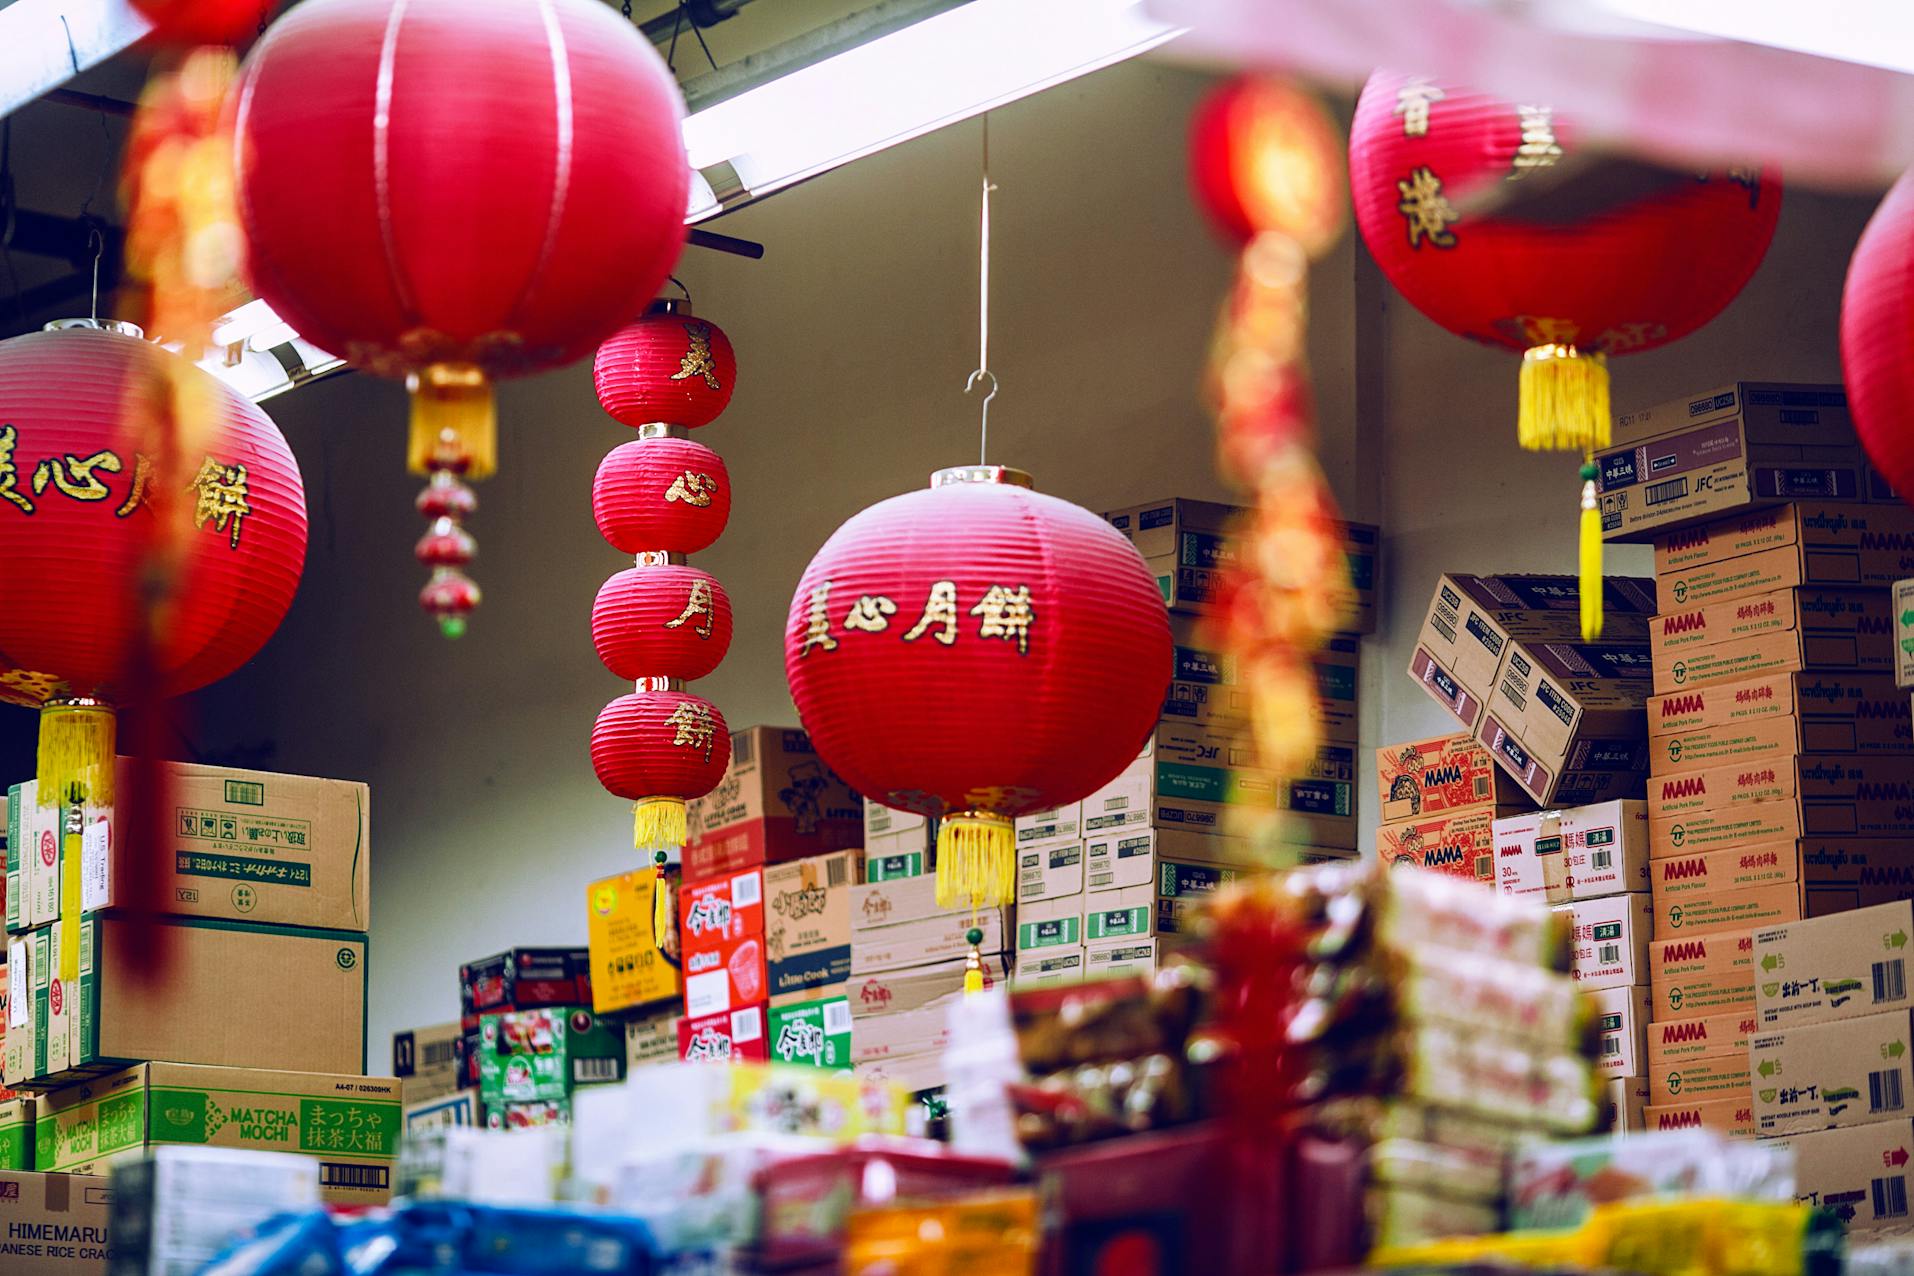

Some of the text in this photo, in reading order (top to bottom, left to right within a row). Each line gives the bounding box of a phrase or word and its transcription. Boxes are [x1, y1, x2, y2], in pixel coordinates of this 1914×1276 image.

[665, 470, 718, 507] 心
[1695, 475, 1713, 493] JFC
[1531, 585, 1580, 597] 中華三
[664, 578, 715, 641] 月
[1498, 612, 1528, 622] JFC
[1478, 620, 1490, 636] ITEM
[1488, 629, 1502, 645] CODE
[1664, 611, 1706, 636] MAMA
[1602, 652, 1652, 664] 中華三
[1570, 681, 1600, 691] JFC
[1549, 687, 1561, 703] ITEM
[1559, 696, 1574, 712] CODE
[1662, 694, 1704, 717] MAMA
[1197, 744, 1219, 759] JFC
[1424, 765, 1462, 788] MAMA
[1662, 777, 1706, 801] MAMA
[1856, 782, 1911, 801] MAMA
[1424, 844, 1463, 867] MAMA
[1500, 844, 1522, 857] MAMA
[1502, 867, 1512, 877] 30
[1664, 858, 1707, 881] MAMA
[1664, 941, 1706, 963] MAMA
[1778, 952, 1785, 969] UP
[803, 967, 829, 982] Cook
[1781, 976, 1819, 999] 出前一丁
[1663, 1022, 1707, 1044] MAMA
[1775, 1056, 1783, 1076] UP
[1779, 1083, 1817, 1105] 出前一丁
[230, 1108, 298, 1126] MATCHA
[309, 1105, 382, 1129] まっちゃ
[67, 1120, 97, 1140] MATCHA
[240, 1125, 289, 1142] MOCHI
[307, 1128, 383, 1151] 抹茶大福
[70, 1135, 93, 1153] MOCHI
[1882, 1150, 1891, 1168] UP
[9, 1222, 107, 1244] HIMEMARU
[0, 1243, 46, 1257] ANESE
[46, 1245, 75, 1258] RICE
